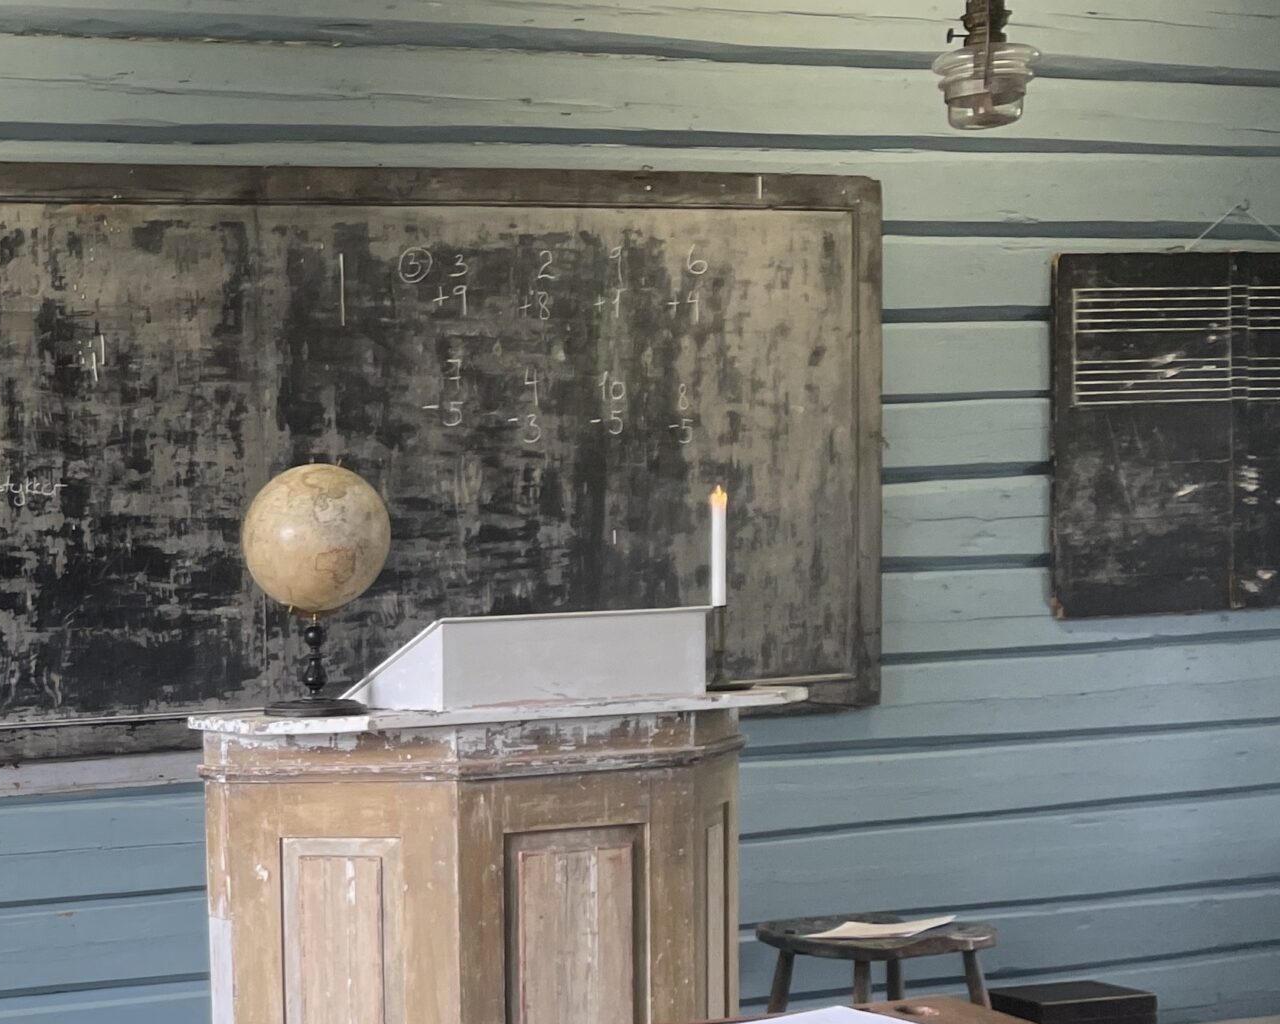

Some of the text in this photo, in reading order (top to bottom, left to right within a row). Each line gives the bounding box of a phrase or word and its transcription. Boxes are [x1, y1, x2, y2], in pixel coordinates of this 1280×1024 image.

[448, 253, 469, 277] 3
[537, 249, 556, 279] 2
[687, 243, 709, 275] 6
[524, 367, 539, 406] 4
[598, 370, 626, 400] 10
[679, 383, 689, 410] 8
